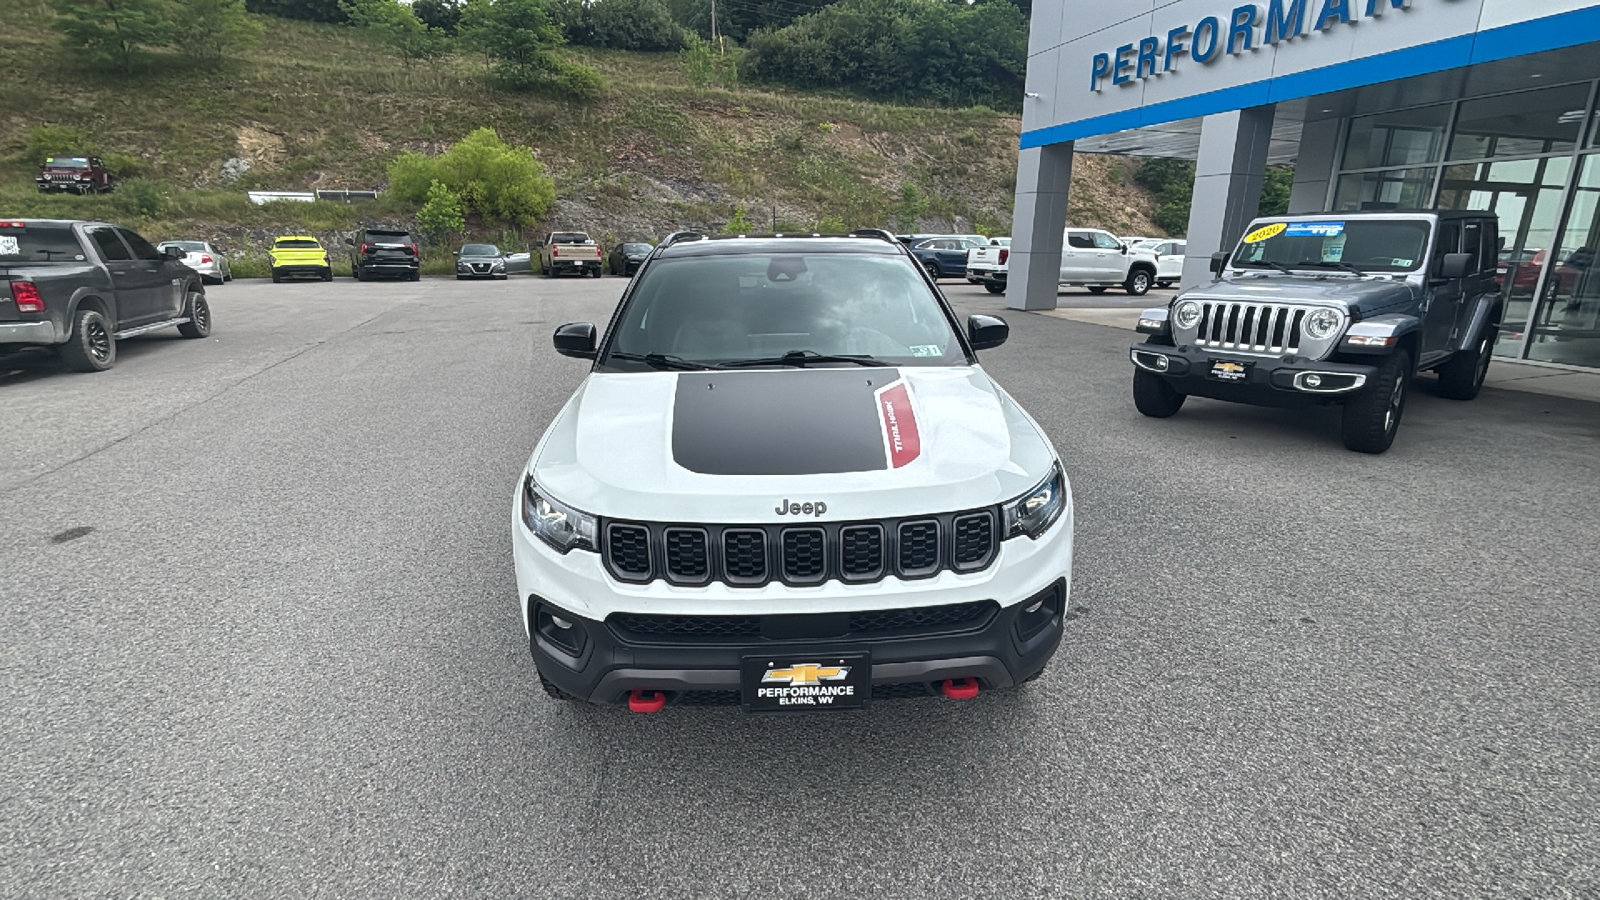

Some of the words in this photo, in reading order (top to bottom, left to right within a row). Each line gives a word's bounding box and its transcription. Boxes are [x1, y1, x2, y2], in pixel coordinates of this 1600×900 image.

[1251, 225, 1280, 241] 2020
[885, 400, 903, 454] TRAILHAWK
[774, 498, 828, 518] Jeep
[757, 685, 855, 698] PERFORMANCE
[779, 696, 817, 706] ELKINS,
[818, 696, 834, 704] WV
